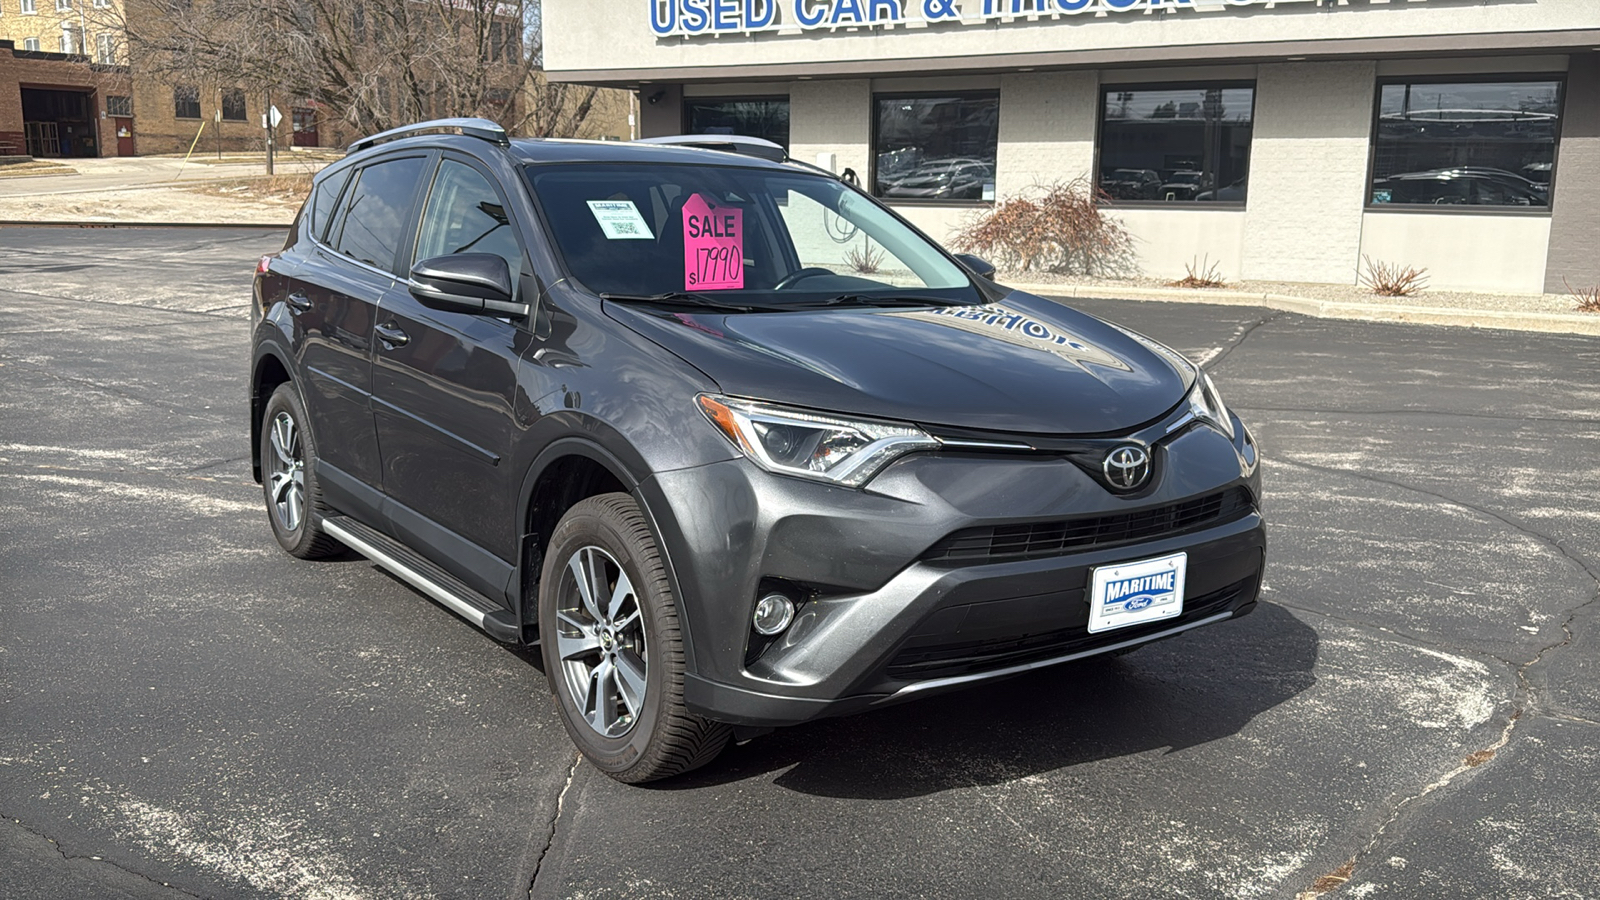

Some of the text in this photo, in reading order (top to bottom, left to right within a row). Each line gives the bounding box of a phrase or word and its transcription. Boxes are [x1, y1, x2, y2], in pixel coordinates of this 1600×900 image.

[649, 0, 774, 34] USED
[688, 214, 736, 238] SALE
[1106, 572, 1175, 603] MARITIME
[1126, 597, 1150, 610] Ford
